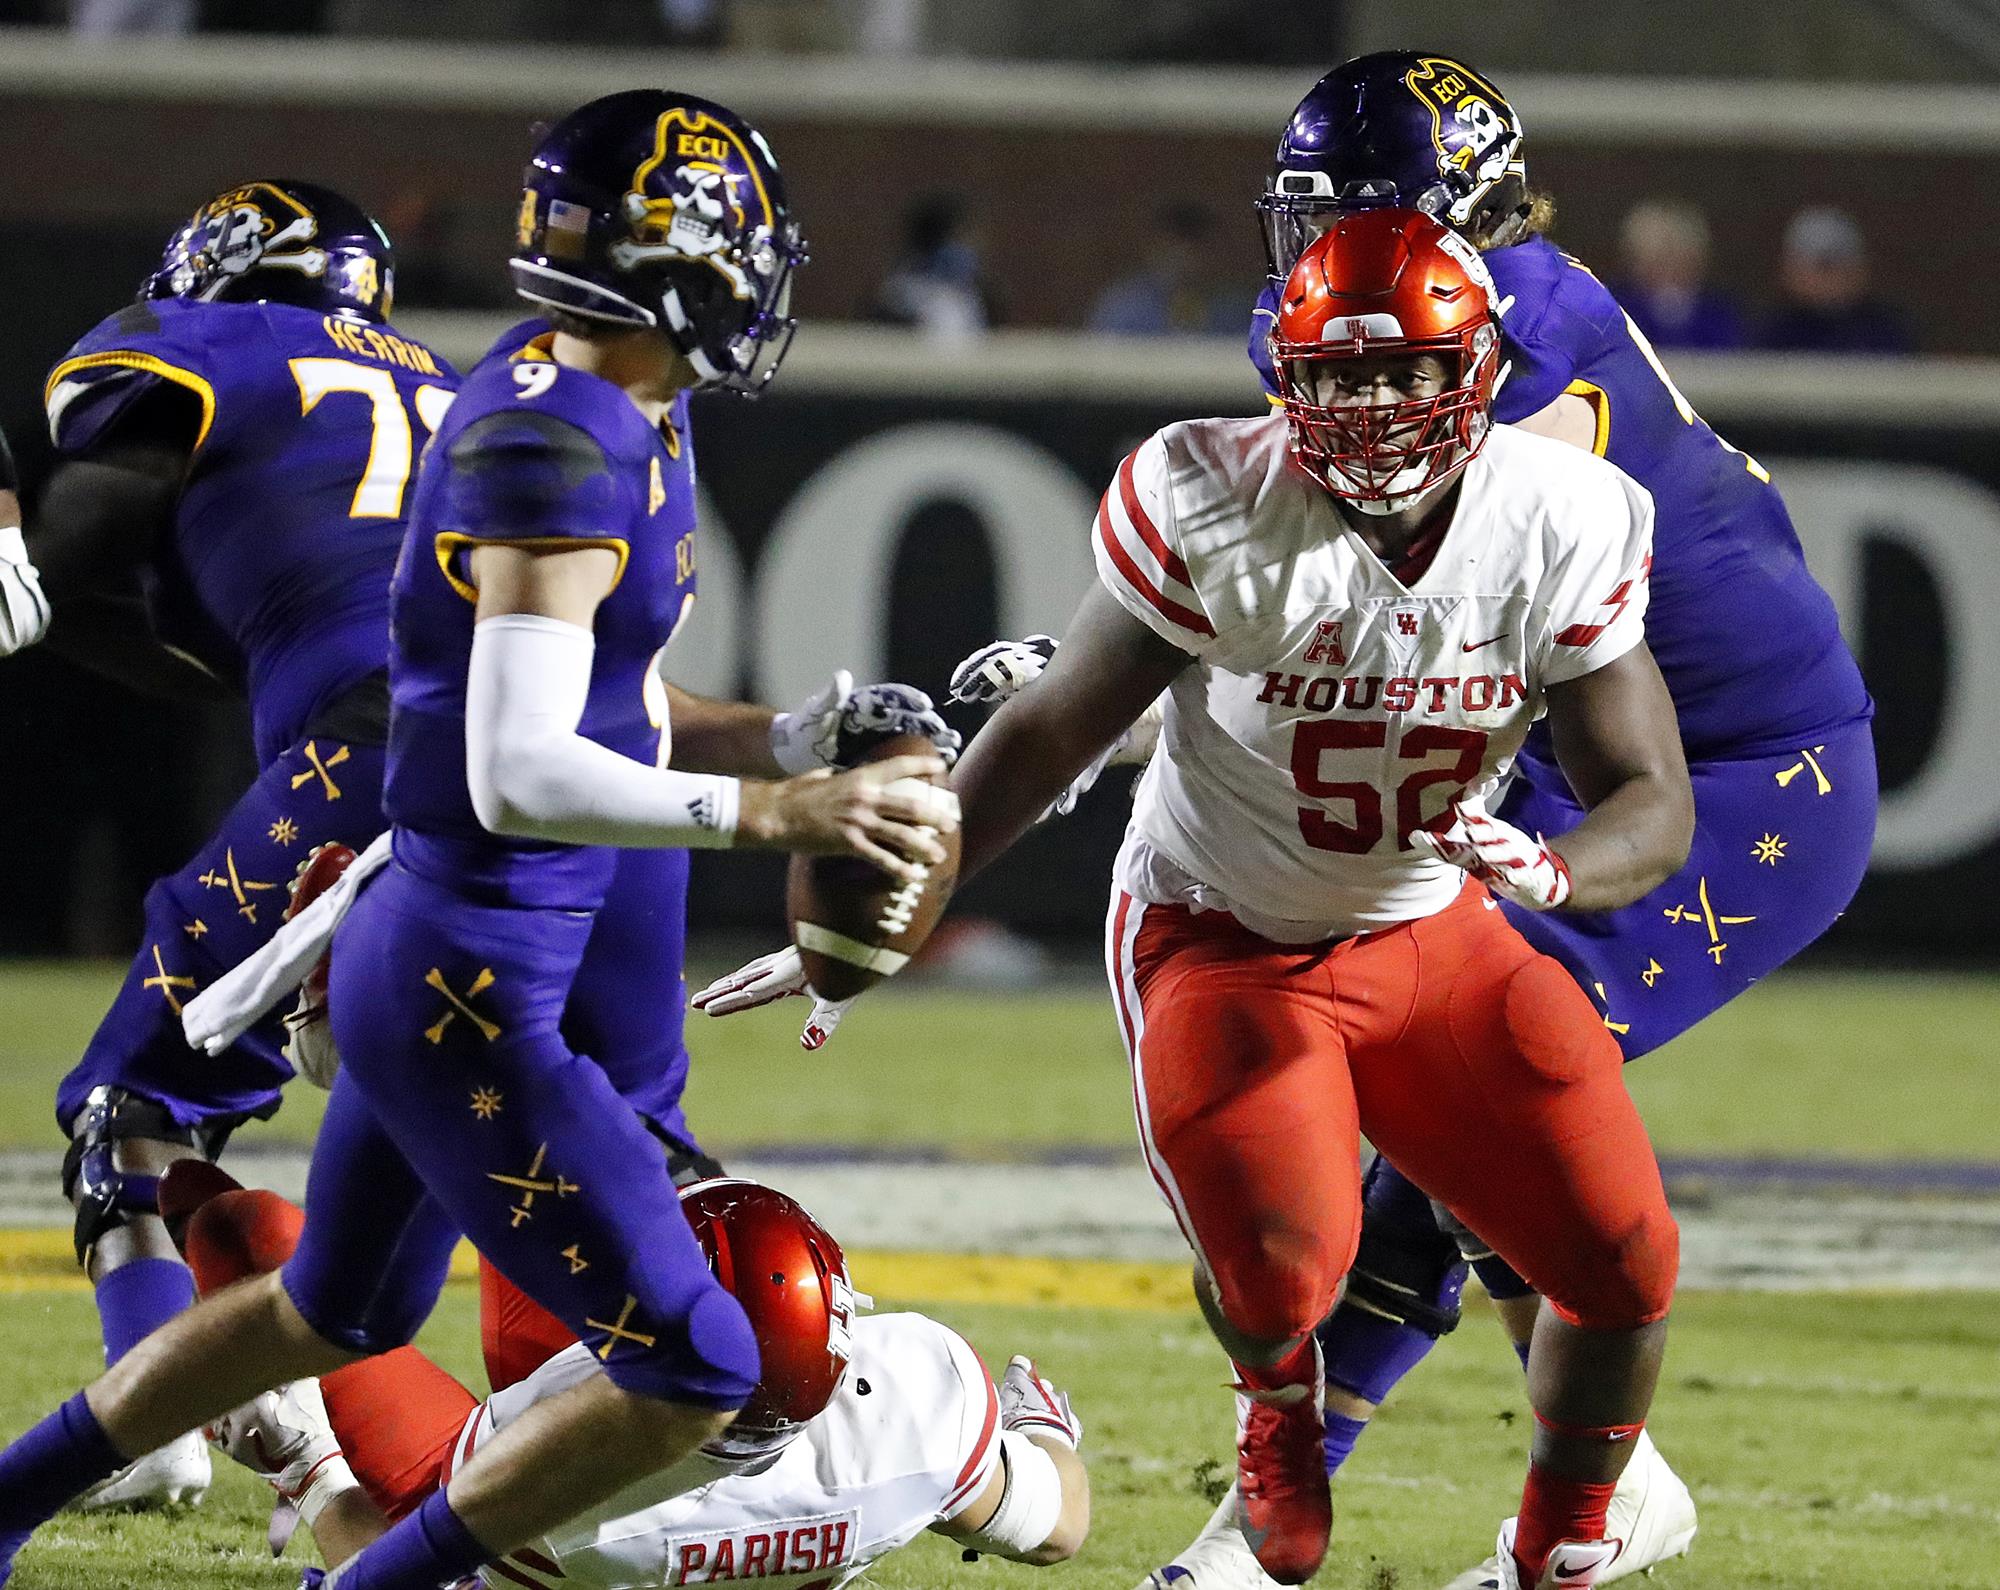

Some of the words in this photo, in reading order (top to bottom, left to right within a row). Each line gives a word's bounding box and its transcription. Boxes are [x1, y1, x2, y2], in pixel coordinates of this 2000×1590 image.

[1431, 73, 1466, 104] ECU
[677, 133, 730, 160] ECU
[323, 316, 444, 377] HERRIN
[512, 362, 558, 399] 9
[1396, 612, 1418, 635] UH
[1256, 672, 1528, 713] HOUSTON
[1290, 719, 1489, 855] 52
[674, 1521, 849, 1587] PARISH
